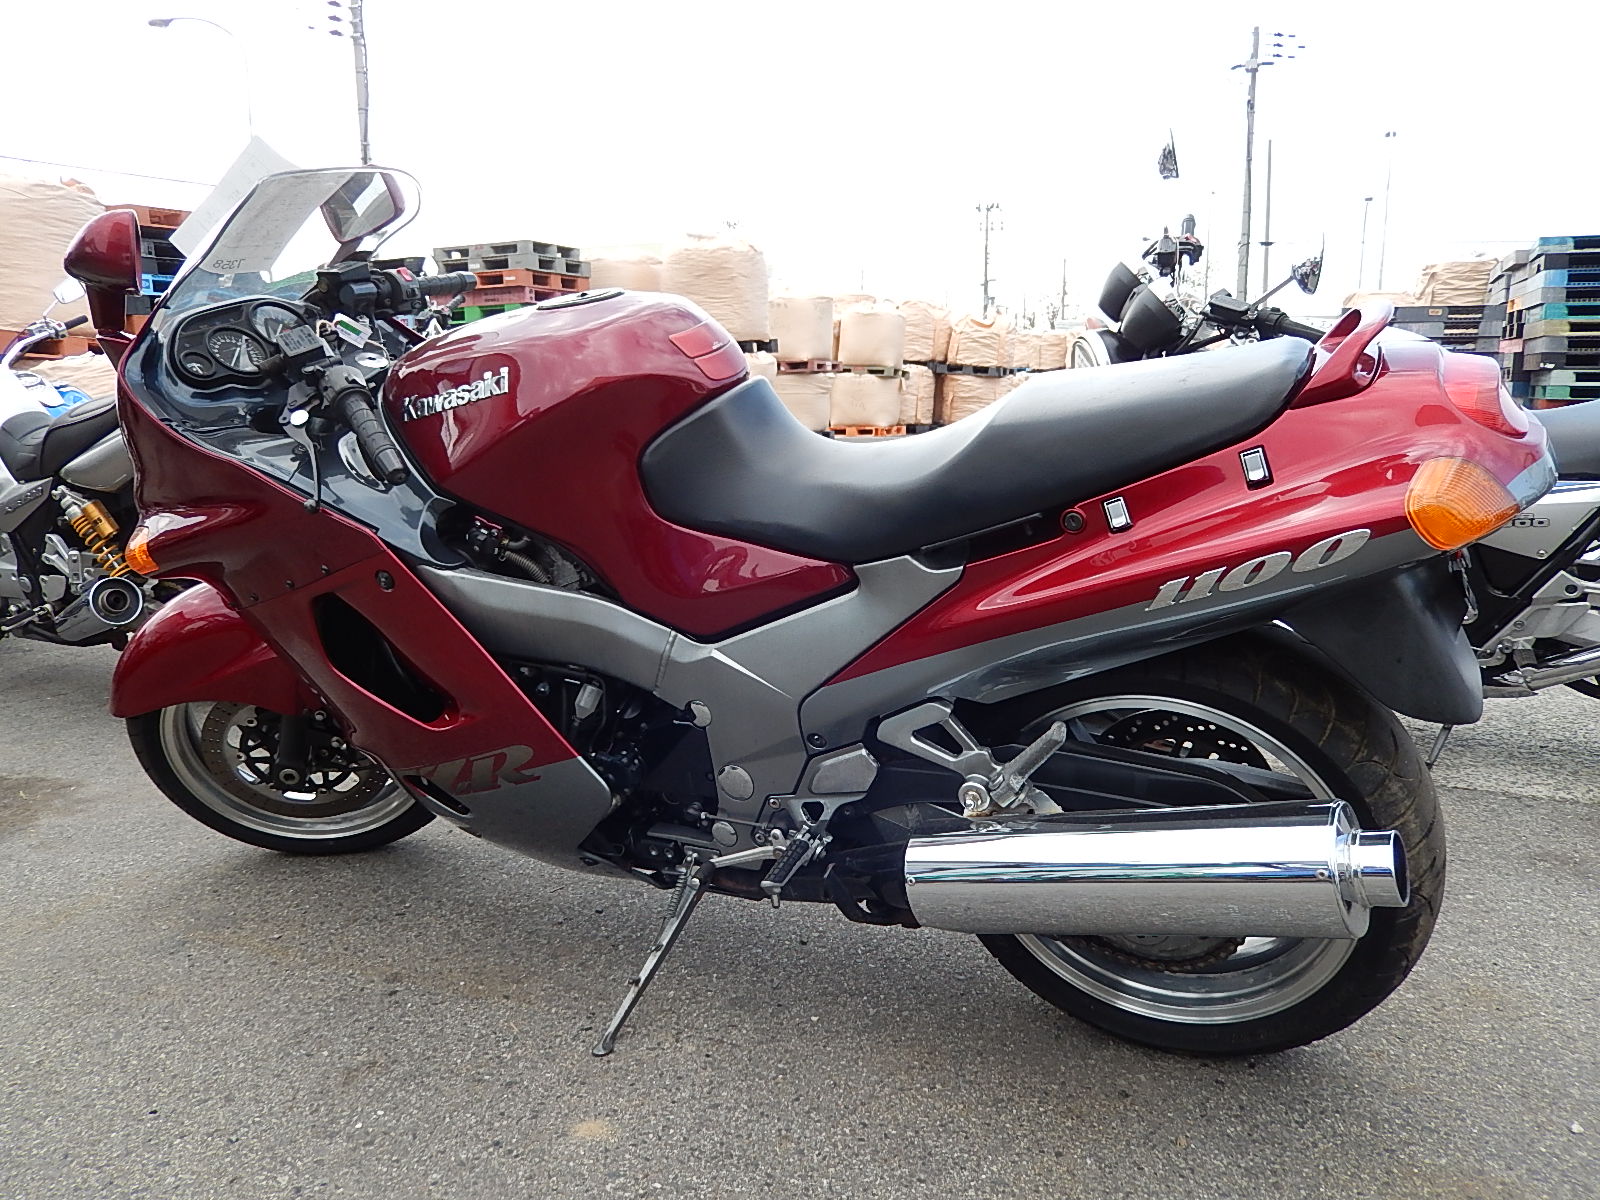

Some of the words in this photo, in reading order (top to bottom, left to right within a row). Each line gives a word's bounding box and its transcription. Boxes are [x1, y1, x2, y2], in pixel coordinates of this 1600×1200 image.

[403, 366, 509, 421] Kawasaki
[1145, 528, 1371, 611] 1100
[412, 744, 541, 796] ZR
